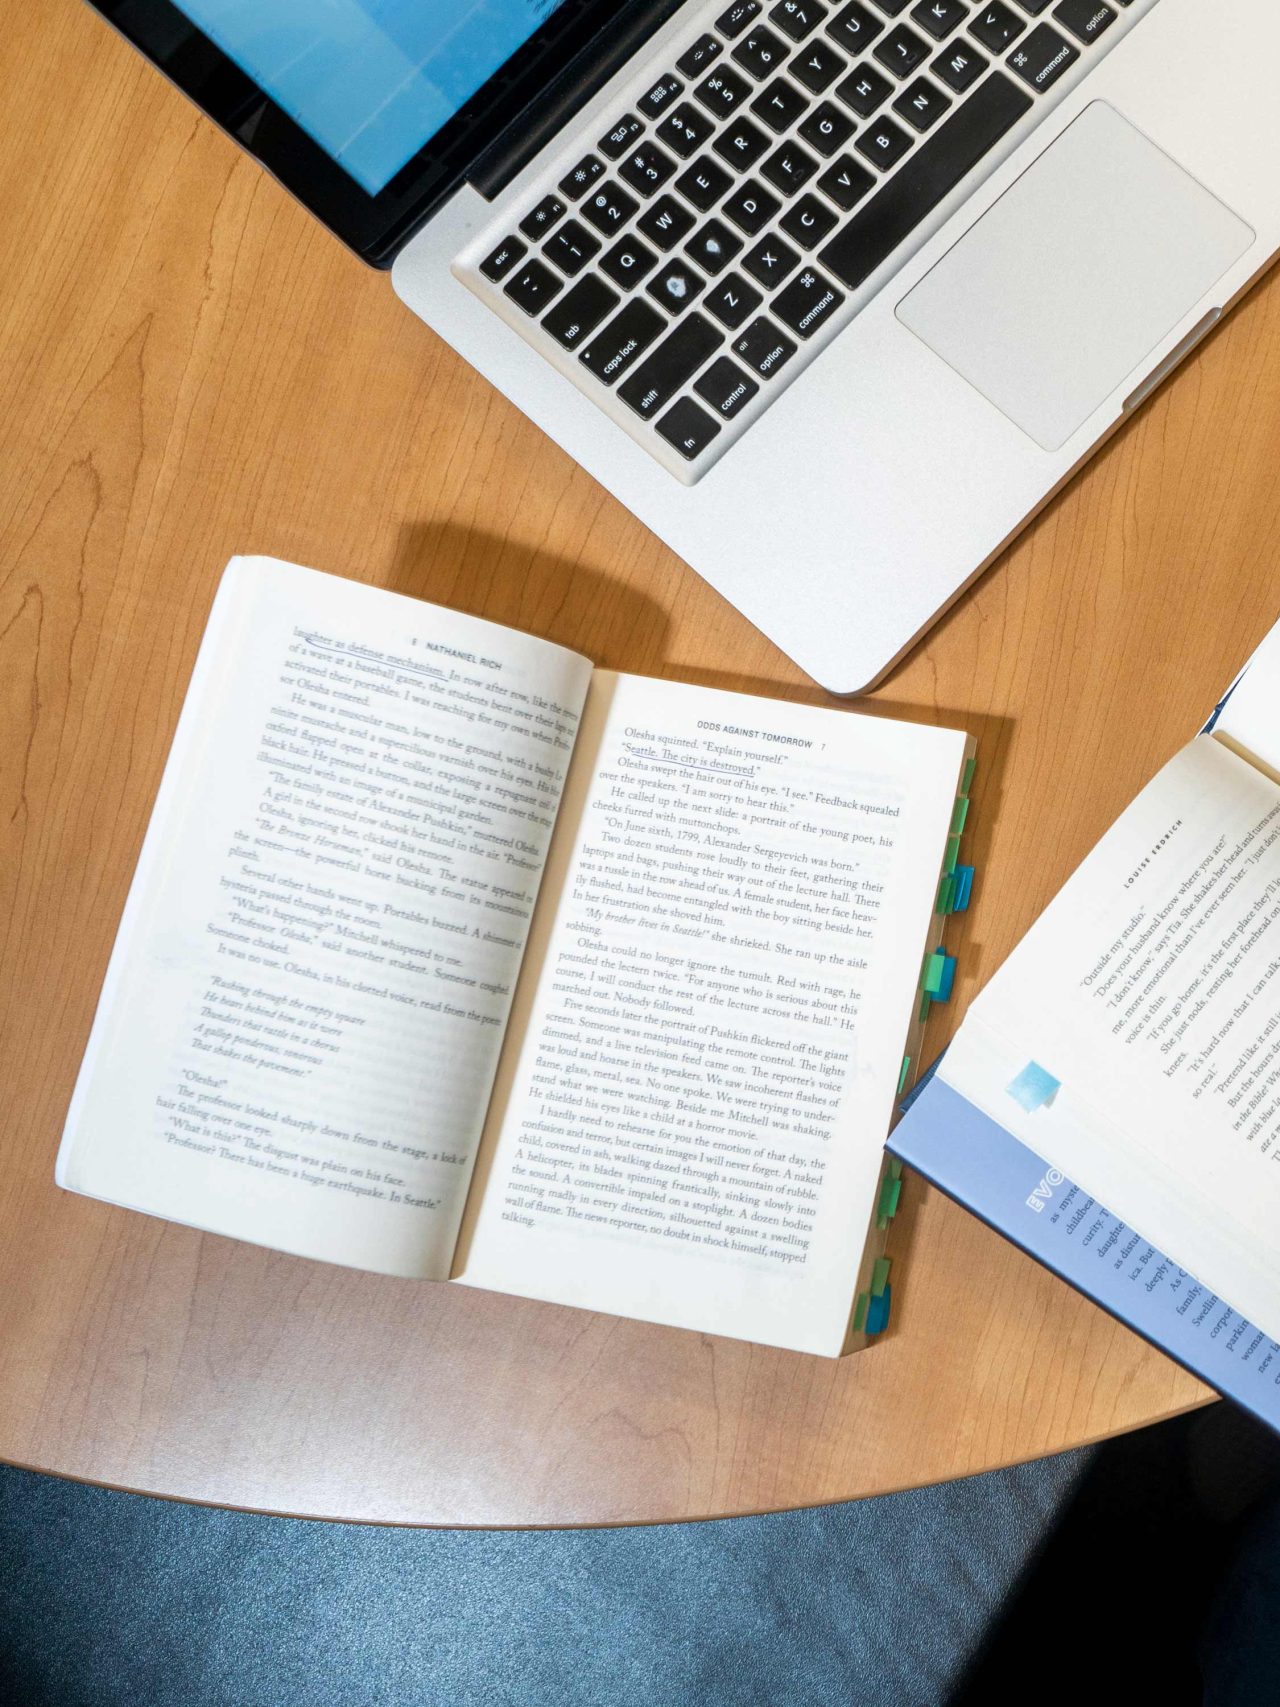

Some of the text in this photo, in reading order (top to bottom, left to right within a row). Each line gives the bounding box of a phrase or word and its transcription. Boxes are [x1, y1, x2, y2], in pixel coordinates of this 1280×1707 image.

[796, 11, 806, 23] 7
[932, 4, 946, 17] K
[846, 19, 860, 32] U
[1086, 8, 1108, 31] option
[761, 51, 771, 61] 6
[898, 44, 907, 56] J
[809, 58, 821, 69] Y
[951, 56, 967, 72] M
[1036, 46, 1069, 83] command
[669, 83, 677, 91] F4
[856, 81, 871, 95] H
[722, 89, 733, 101] 5
[772, 97, 784, 108] T
[913, 95, 928, 110] N
[820, 121, 832, 133] G
[686, 129, 695, 139] 4
[734, 137, 748, 150] R
[876, 136, 889, 148] B
[782, 160, 792, 173] F
[646, 169, 657, 179] 3
[838, 173, 850, 185] V
[696, 176, 709, 188] E
[608, 207, 620, 219] 2
[743, 200, 756, 213] D
[656, 213, 672, 229] W
[801, 213, 814, 226] C
[495, 251, 508, 265] esc
[570, 247, 581, 256] 1
[621, 255, 635, 267] Q
[762, 252, 777, 267] X
[724, 292, 738, 307] Z
[799, 291, 834, 329] command
[565, 325, 579, 339] tab
[604, 340, 637, 374] caps lock
[760, 346, 783, 370] option
[641, 390, 658, 408] shift
[721, 383, 746, 410] control
[684, 439, 695, 448] fn
[623, 726, 655, 741] Olesha
[656, 735, 699, 749] squinted.
[696, 719, 721, 732] ODDS
[721, 724, 760, 738] AGAINST
[761, 731, 813, 748] TOMORROW
[610, 785, 894, 847] He called up the next slide: a portrait of the young poet, his
[1123, 819, 1182, 889] LOUISE ERDRICH
[1114, 952, 1133, 977] your
[1128, 916, 1161, 955] husband
[1155, 894, 1179, 920] know
[1177, 869, 1201, 895] where
[1197, 854, 1214, 873] you
[1109, 938, 1124, 954] my
[1025, 1167, 1065, 1214] EVO
[1050, 1213, 1060, 1223] as
[1145, 1263, 1169, 1292] deeply
[1170, 1279, 1181, 1292] As
[1258, 1353, 1273, 1373] new
